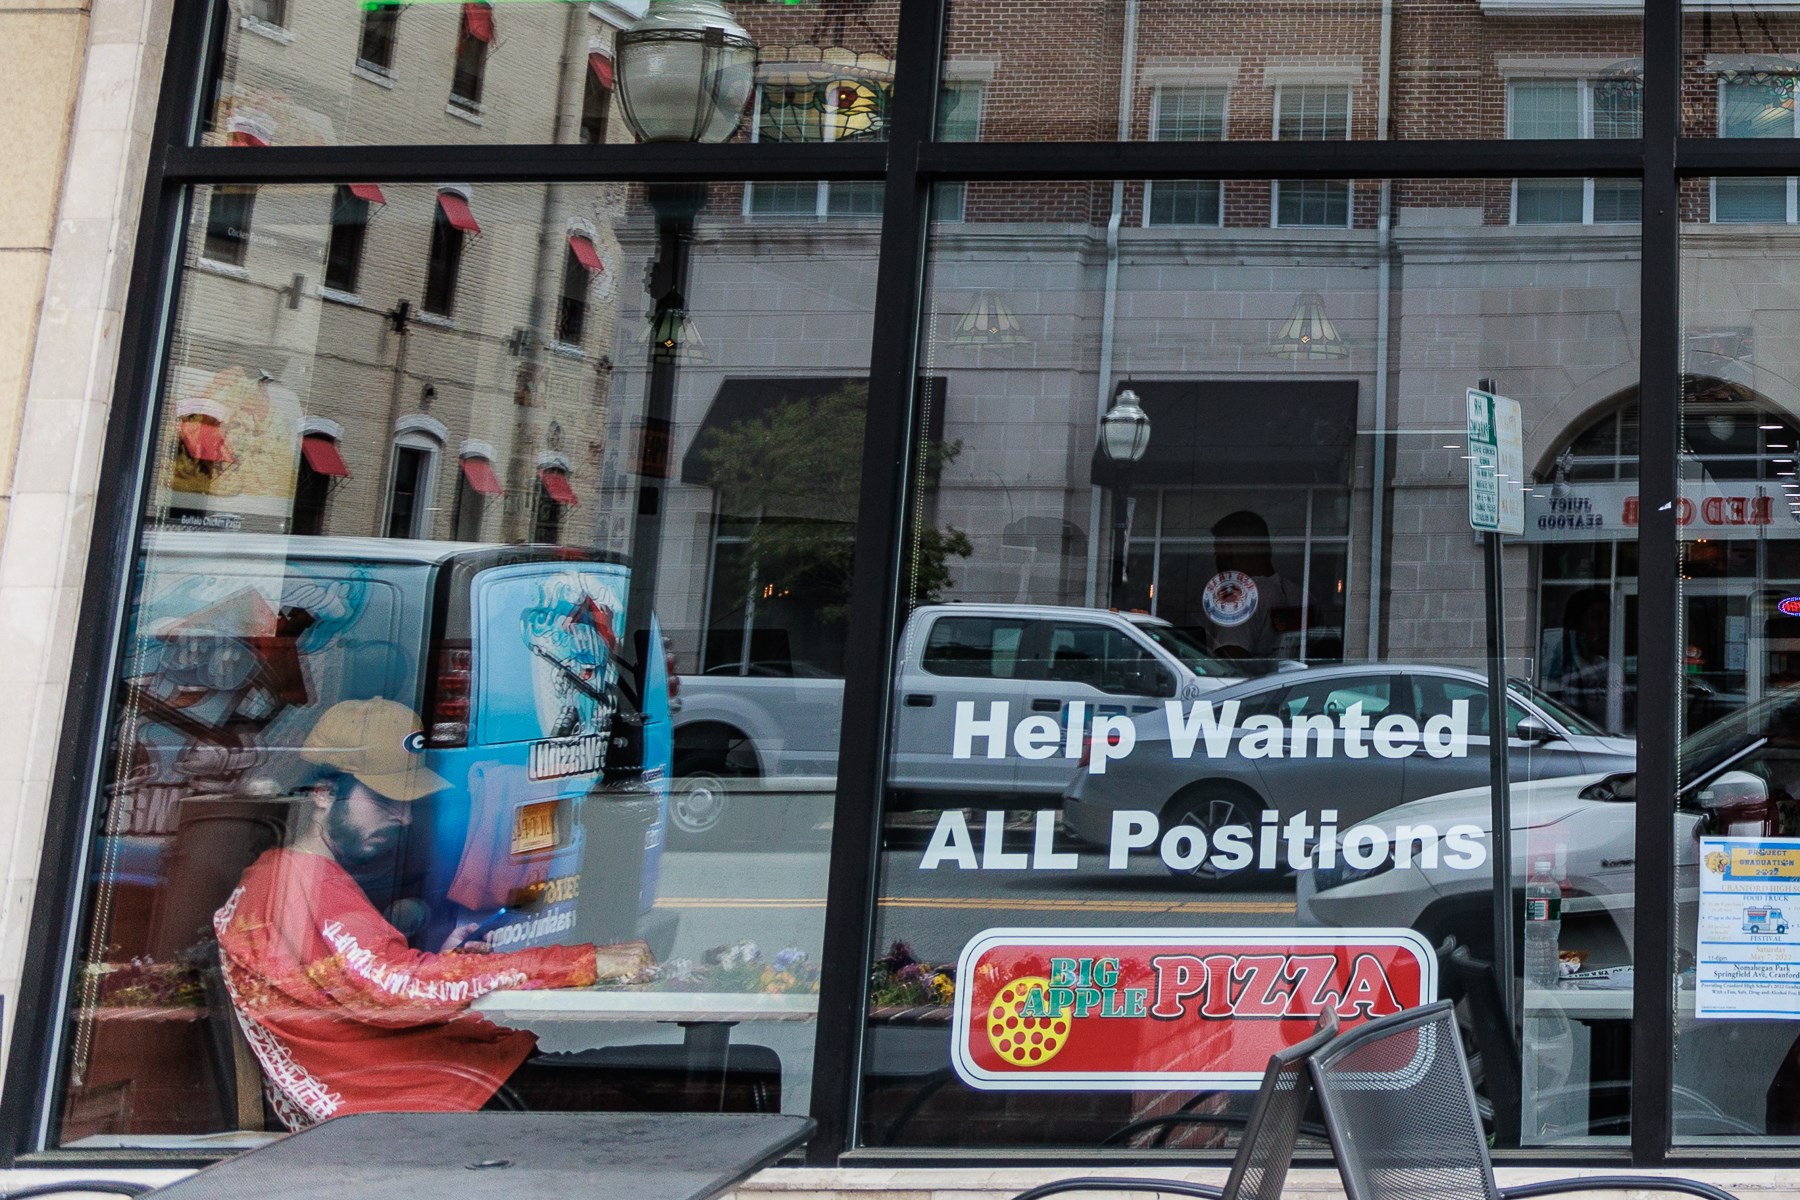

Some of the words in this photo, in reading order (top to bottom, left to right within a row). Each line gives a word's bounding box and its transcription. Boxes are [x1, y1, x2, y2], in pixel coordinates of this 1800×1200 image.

[952, 700, 1136, 774] Help
[1164, 699, 1469, 760] Wanted
[919, 810, 1078, 870] ALL
[1109, 809, 1488, 870] Positions
[1721, 884, 1768, 892] CRANFORD
[1770, 884, 1792, 892] HIGH
[1750, 953, 1765, 961] May
[1756, 946, 1786, 954] Saturday
[1050, 956, 1120, 987] BIG
[1713, 971, 1751, 980] Springfield
[1733, 964, 1773, 972] Nomahegan
[1775, 964, 1790, 972] Park
[1150, 953, 1403, 1021] PIZZA
[1019, 986, 1148, 1019] APPLE
